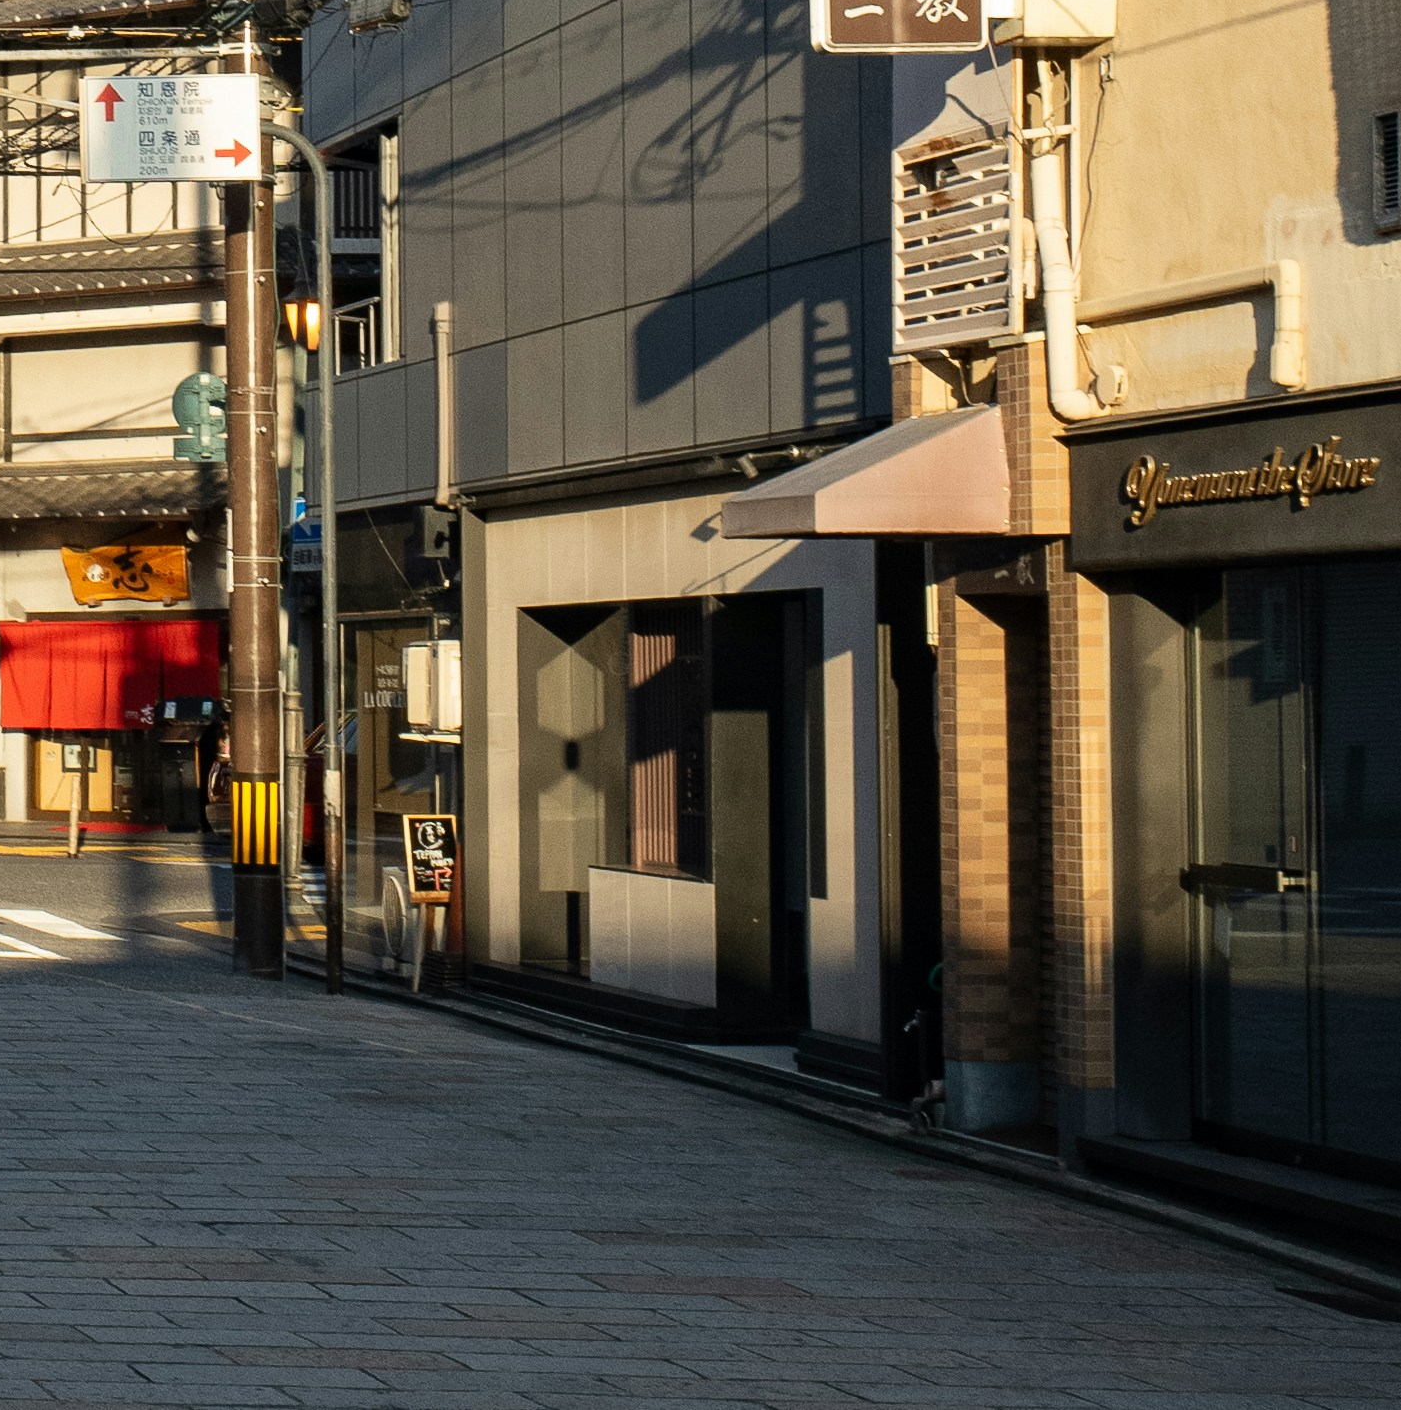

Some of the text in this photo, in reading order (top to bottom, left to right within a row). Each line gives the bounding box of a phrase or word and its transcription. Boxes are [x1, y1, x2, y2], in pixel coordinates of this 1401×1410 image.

[137, 81, 200, 98] 知恩院
[137, 98, 179, 107] CHION-IN
[139, 116, 169, 126] 610m
[138, 130, 201, 147] 四条通
[139, 147, 168, 156] SHIJO
[138, 166, 169, 176] 200m
